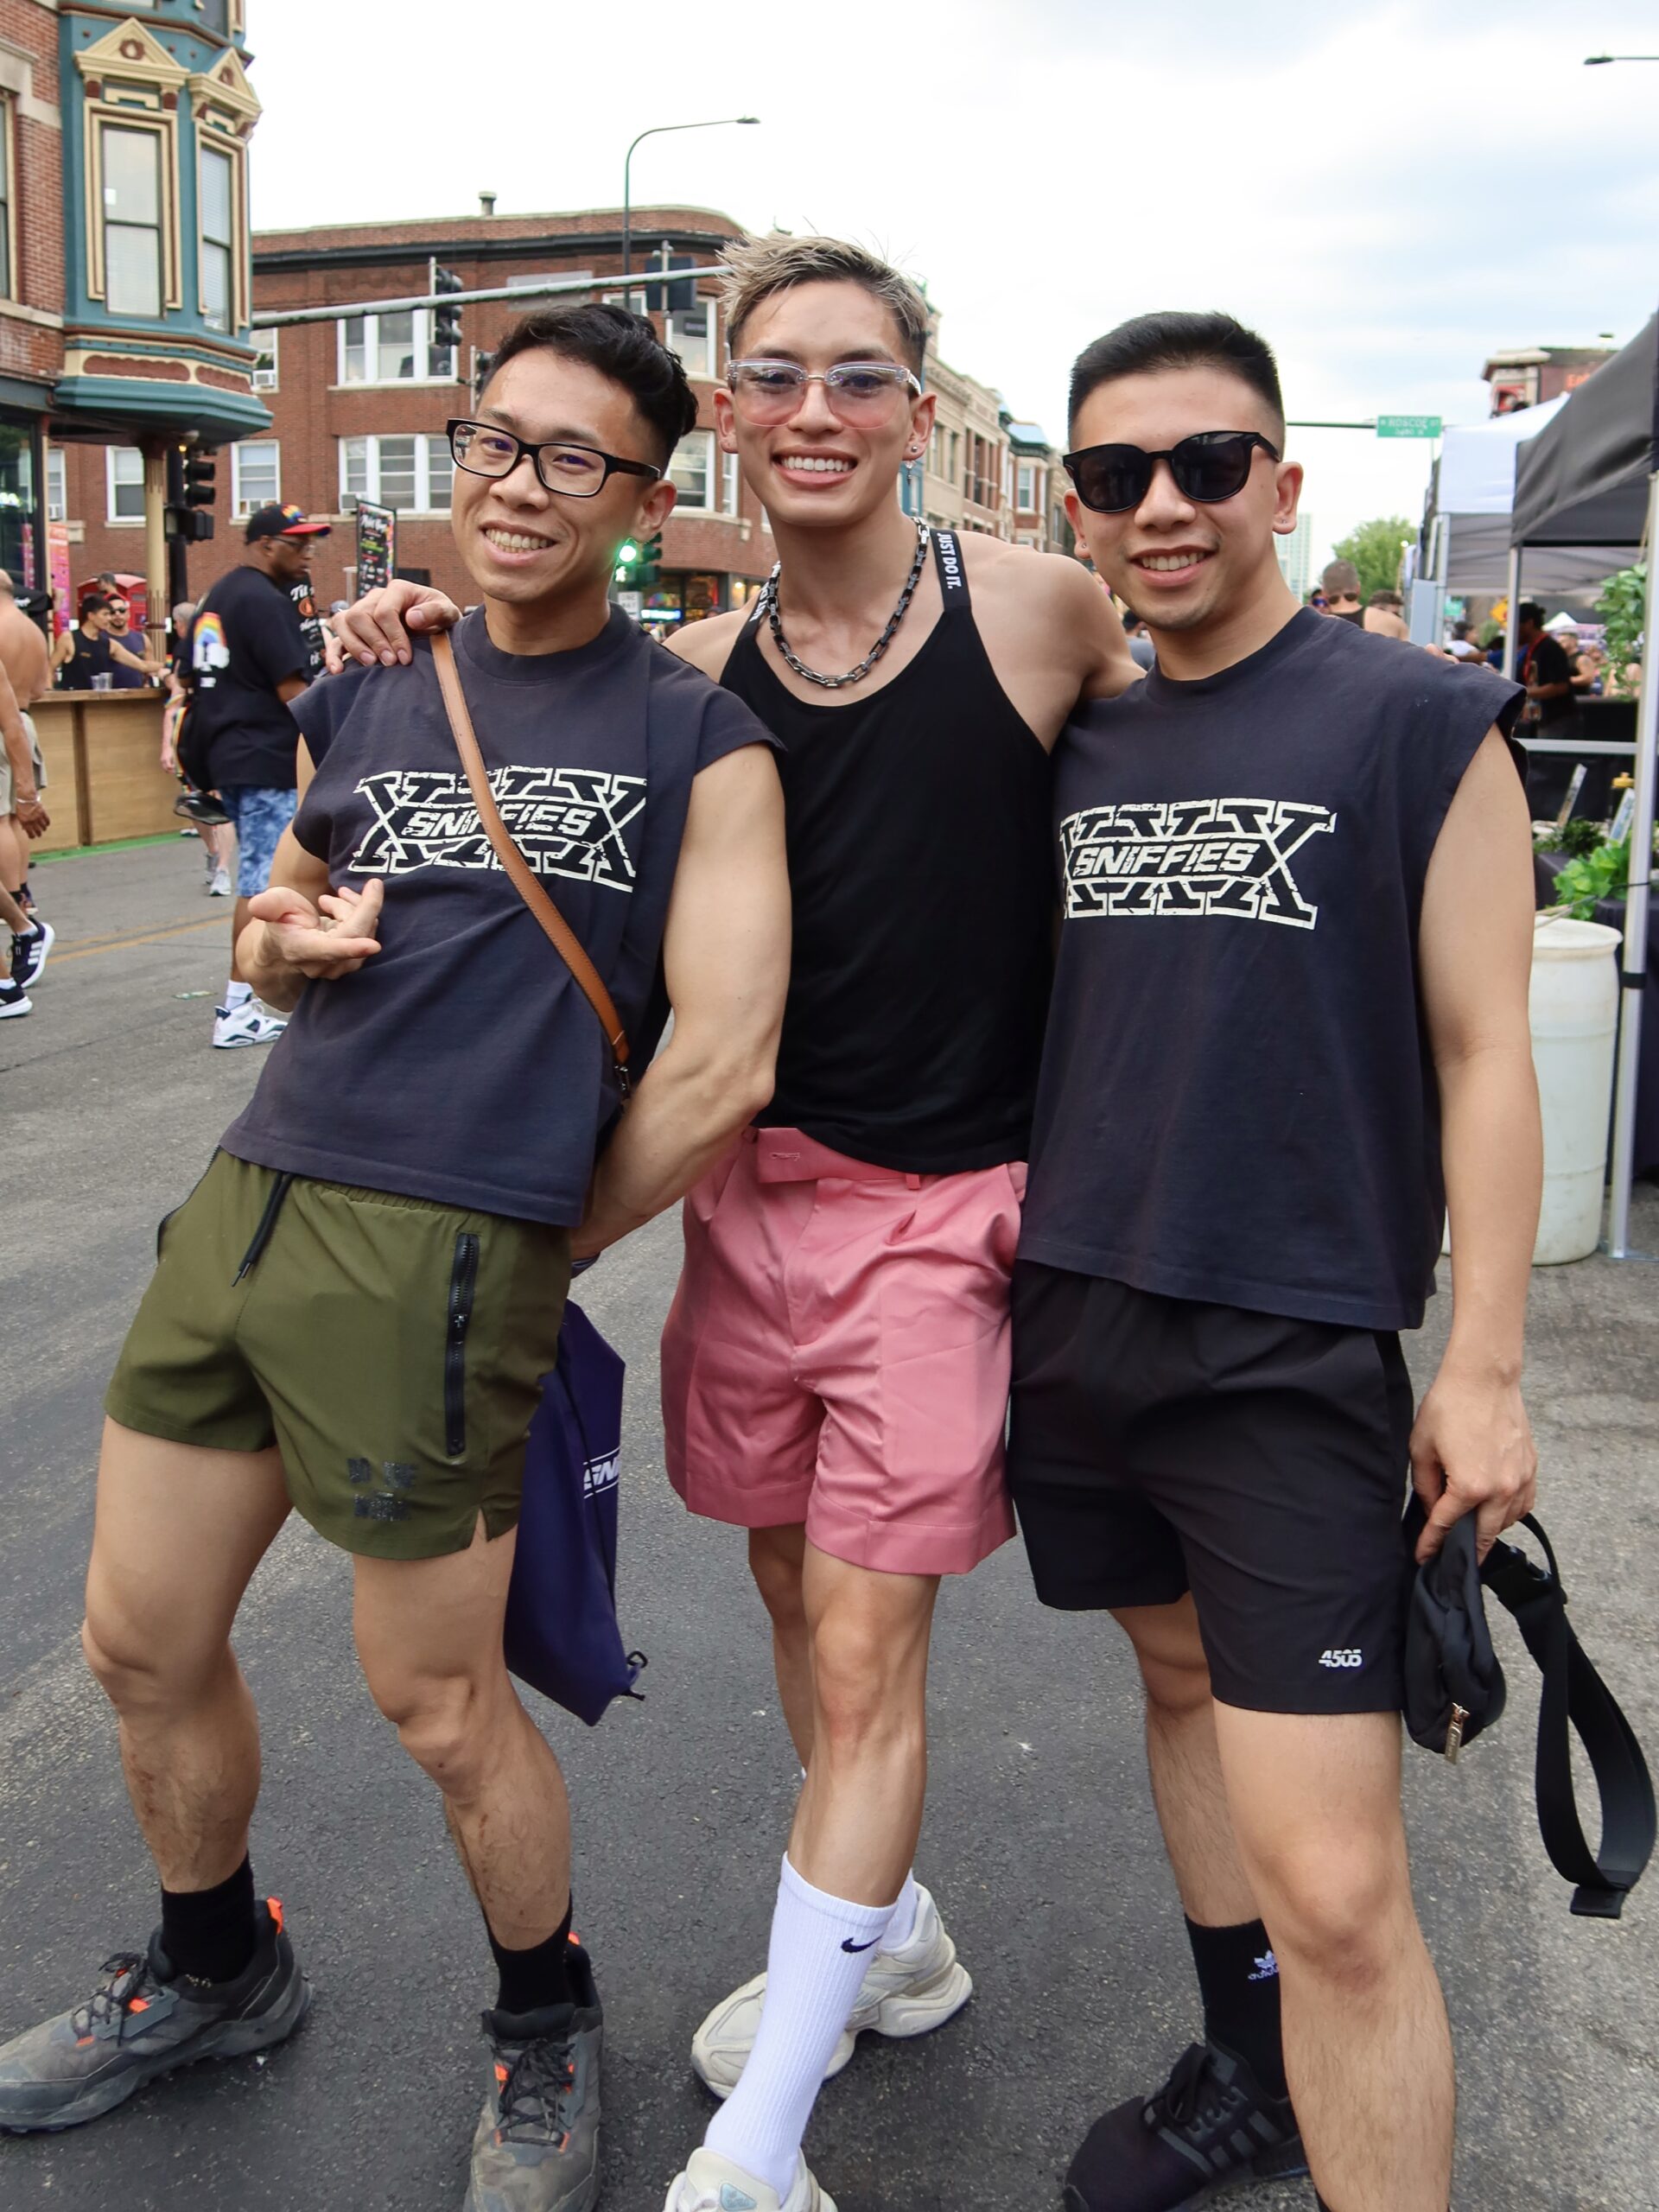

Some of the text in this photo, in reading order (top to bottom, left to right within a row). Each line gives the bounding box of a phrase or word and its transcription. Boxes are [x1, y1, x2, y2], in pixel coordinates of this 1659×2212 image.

[937, 532, 962, 589] JUST DO IT.
[1072, 841, 1261, 876] SNIFFIES
